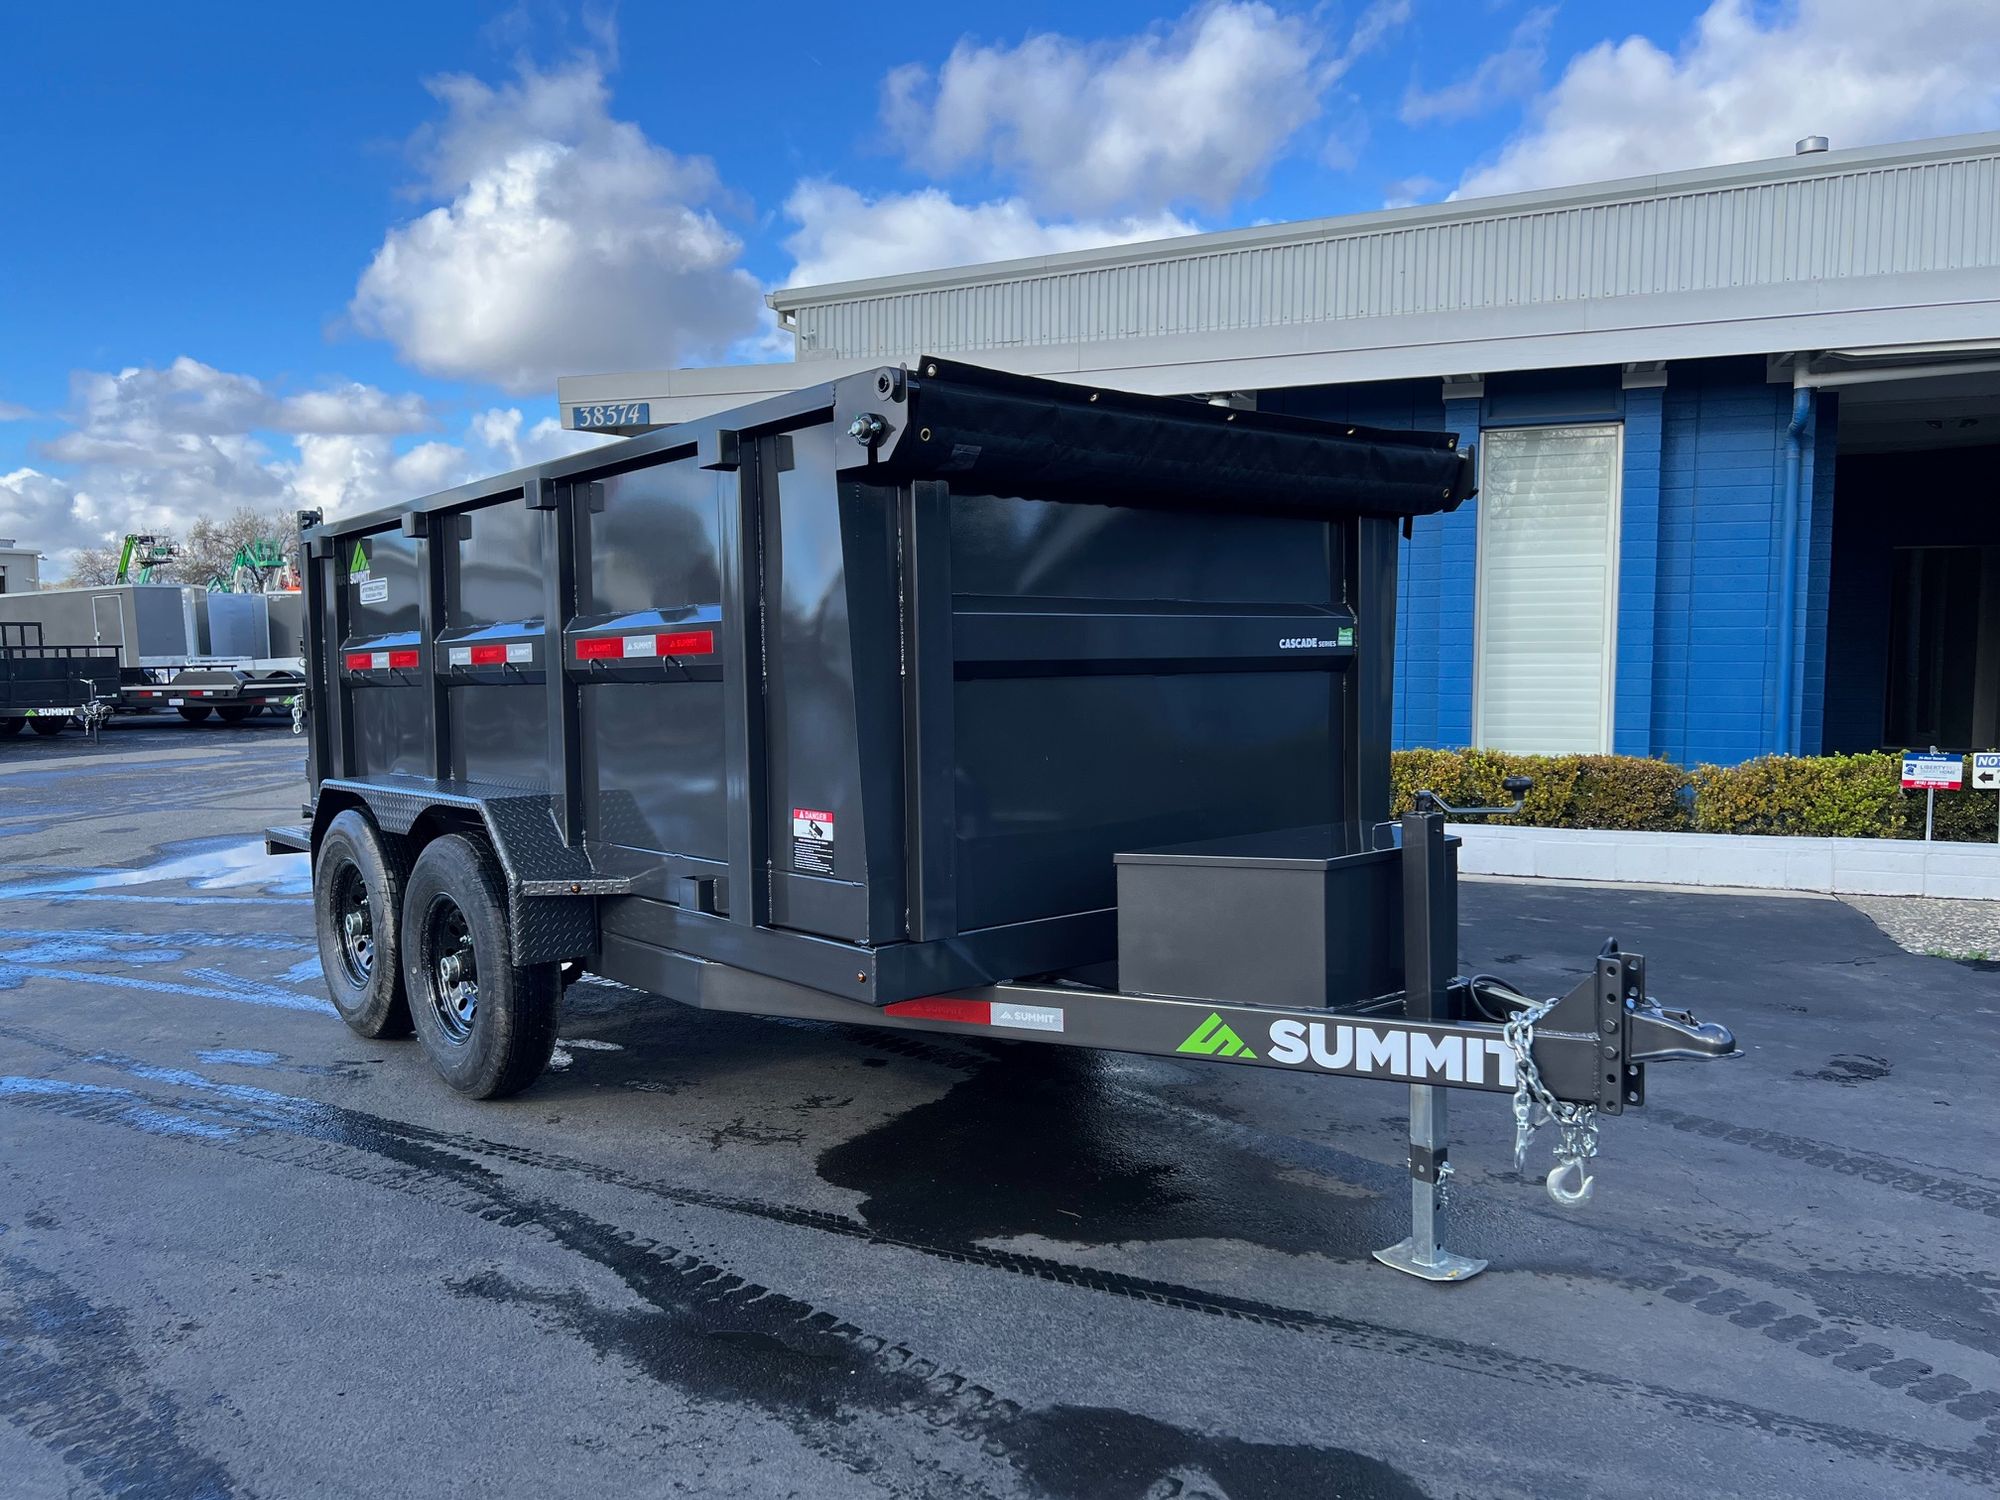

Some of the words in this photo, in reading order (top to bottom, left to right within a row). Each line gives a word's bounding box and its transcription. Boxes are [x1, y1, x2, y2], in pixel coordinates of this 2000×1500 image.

[579, 404, 640, 427] 38574
[1279, 638, 1318, 649] CASCADE
[1318, 640, 1337, 648] SERIES
[38, 708, 75, 716] SUMMIT
[1977, 756, 2000, 767] NO
[804, 811, 828, 820] DANGER
[1014, 1010, 1056, 1024] SUMMIT
[1267, 1019, 1518, 1087] SUMMIT
